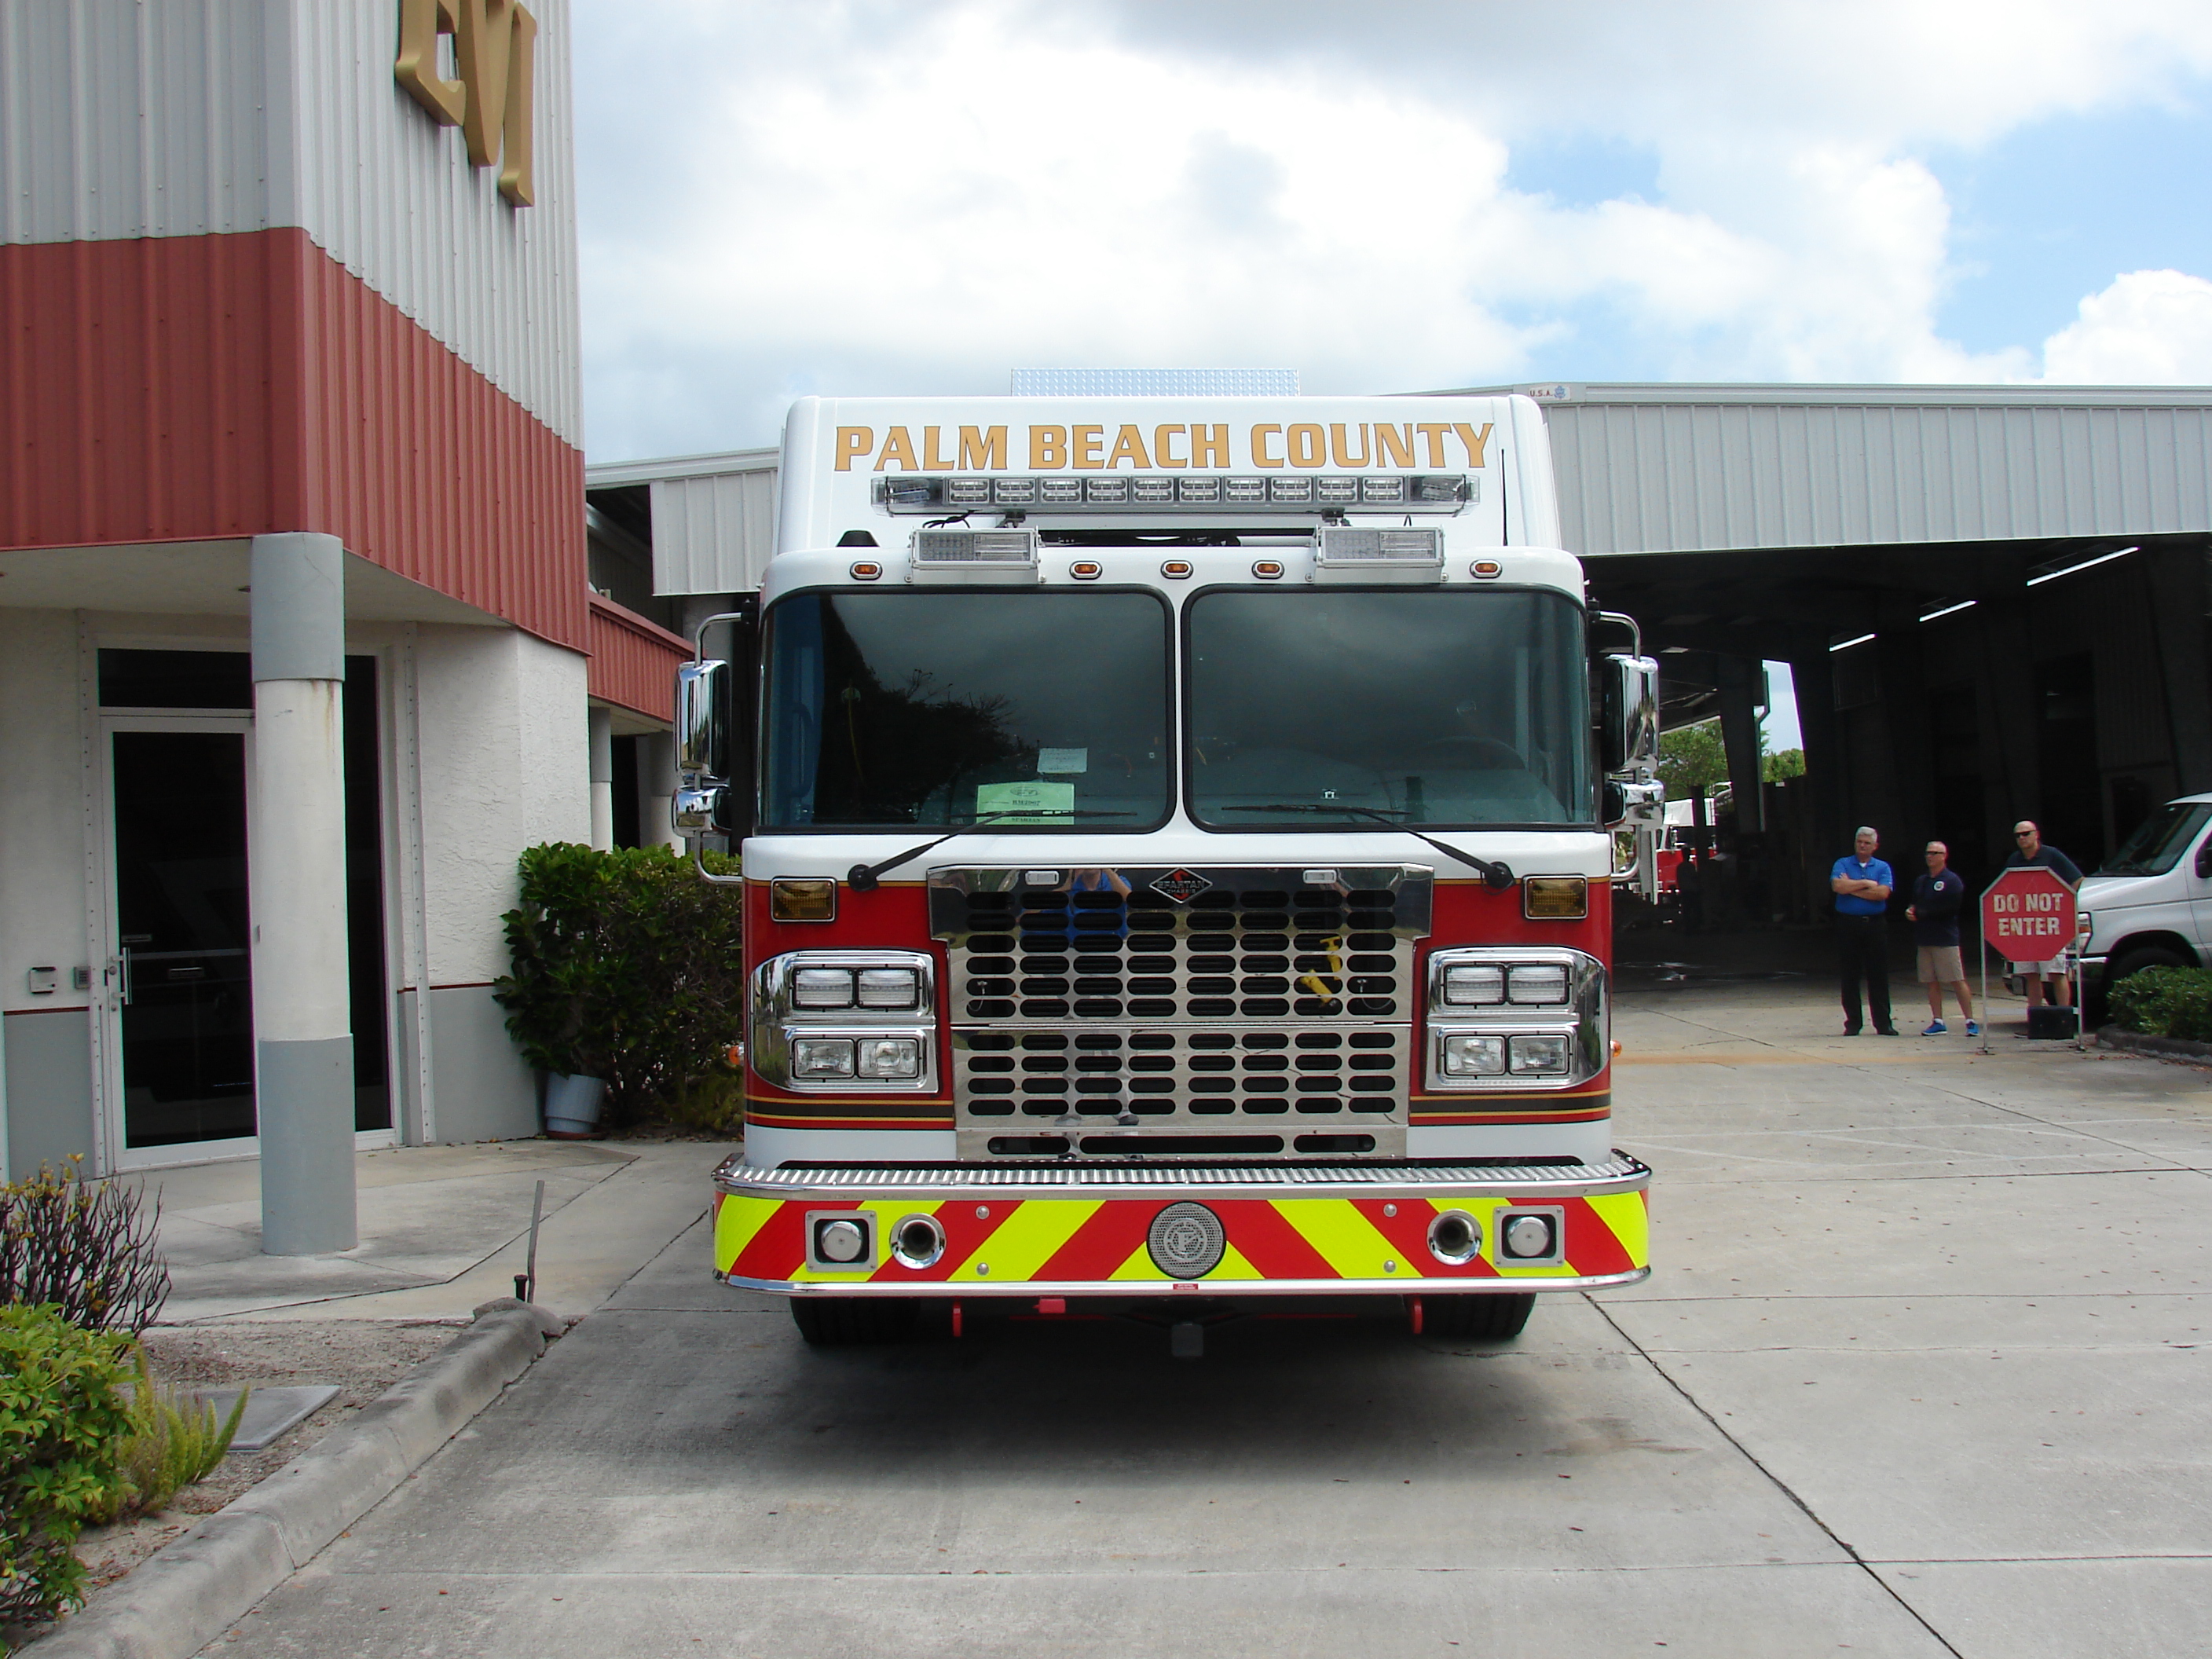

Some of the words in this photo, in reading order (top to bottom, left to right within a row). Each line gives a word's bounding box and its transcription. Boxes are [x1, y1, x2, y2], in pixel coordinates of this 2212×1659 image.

[834, 425, 1009, 471] PALM
[1028, 423, 1231, 470] BEACH
[1251, 423, 1494, 469] COUNTY
[1157, 881, 1205, 889] SPARTAN
[1993, 894, 2020, 913] DO
[2025, 893, 2064, 912] NOT
[1998, 917, 2060, 936] ENTER
